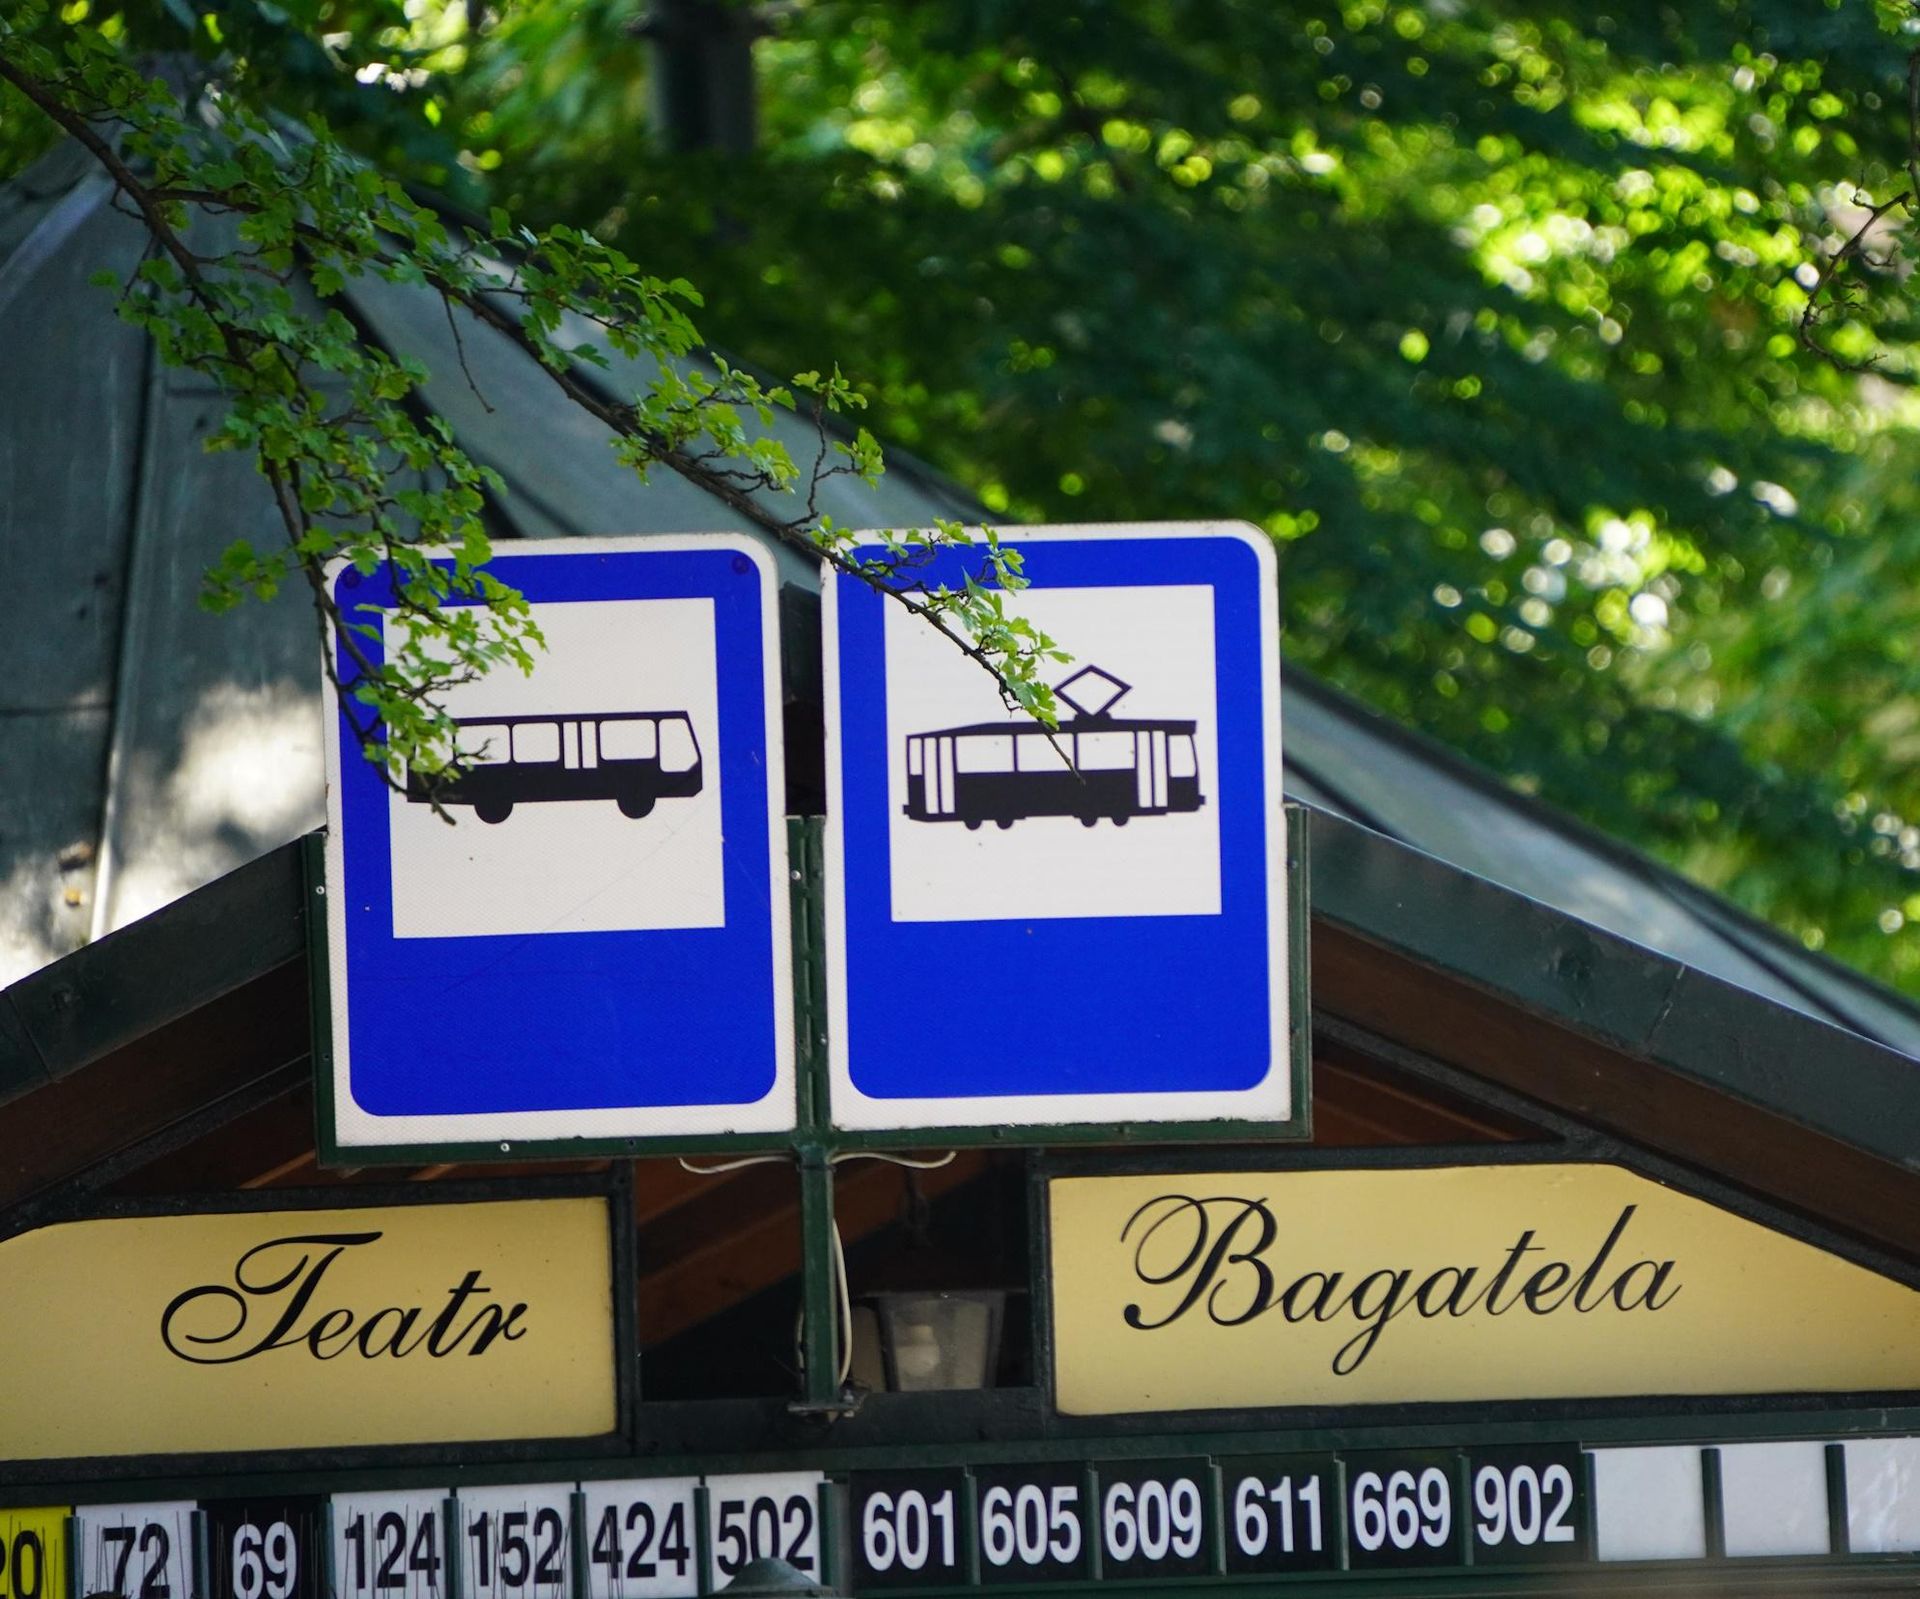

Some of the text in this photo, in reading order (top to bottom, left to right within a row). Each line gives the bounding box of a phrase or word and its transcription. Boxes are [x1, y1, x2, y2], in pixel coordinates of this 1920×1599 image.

[161, 1231, 528, 1365] Teatr
[1120, 1194, 1683, 1376] Bagatela
[592, 1502, 690, 1580] 424
[717, 1495, 813, 1576] 502
[863, 1489, 955, 1571] 601
[982, 1484, 1081, 1566] 605
[1104, 1478, 1202, 1561] 609
[1235, 1475, 1322, 1556] 611
[1353, 1467, 1451, 1551] 669
[1475, 1464, 1575, 1546] 902
[0, 1530, 42, 1599] 0
[103, 1523, 170, 1599] 72
[233, 1521, 297, 1599] 69
[345, 1511, 440, 1590] 124
[468, 1508, 562, 1588] 152
